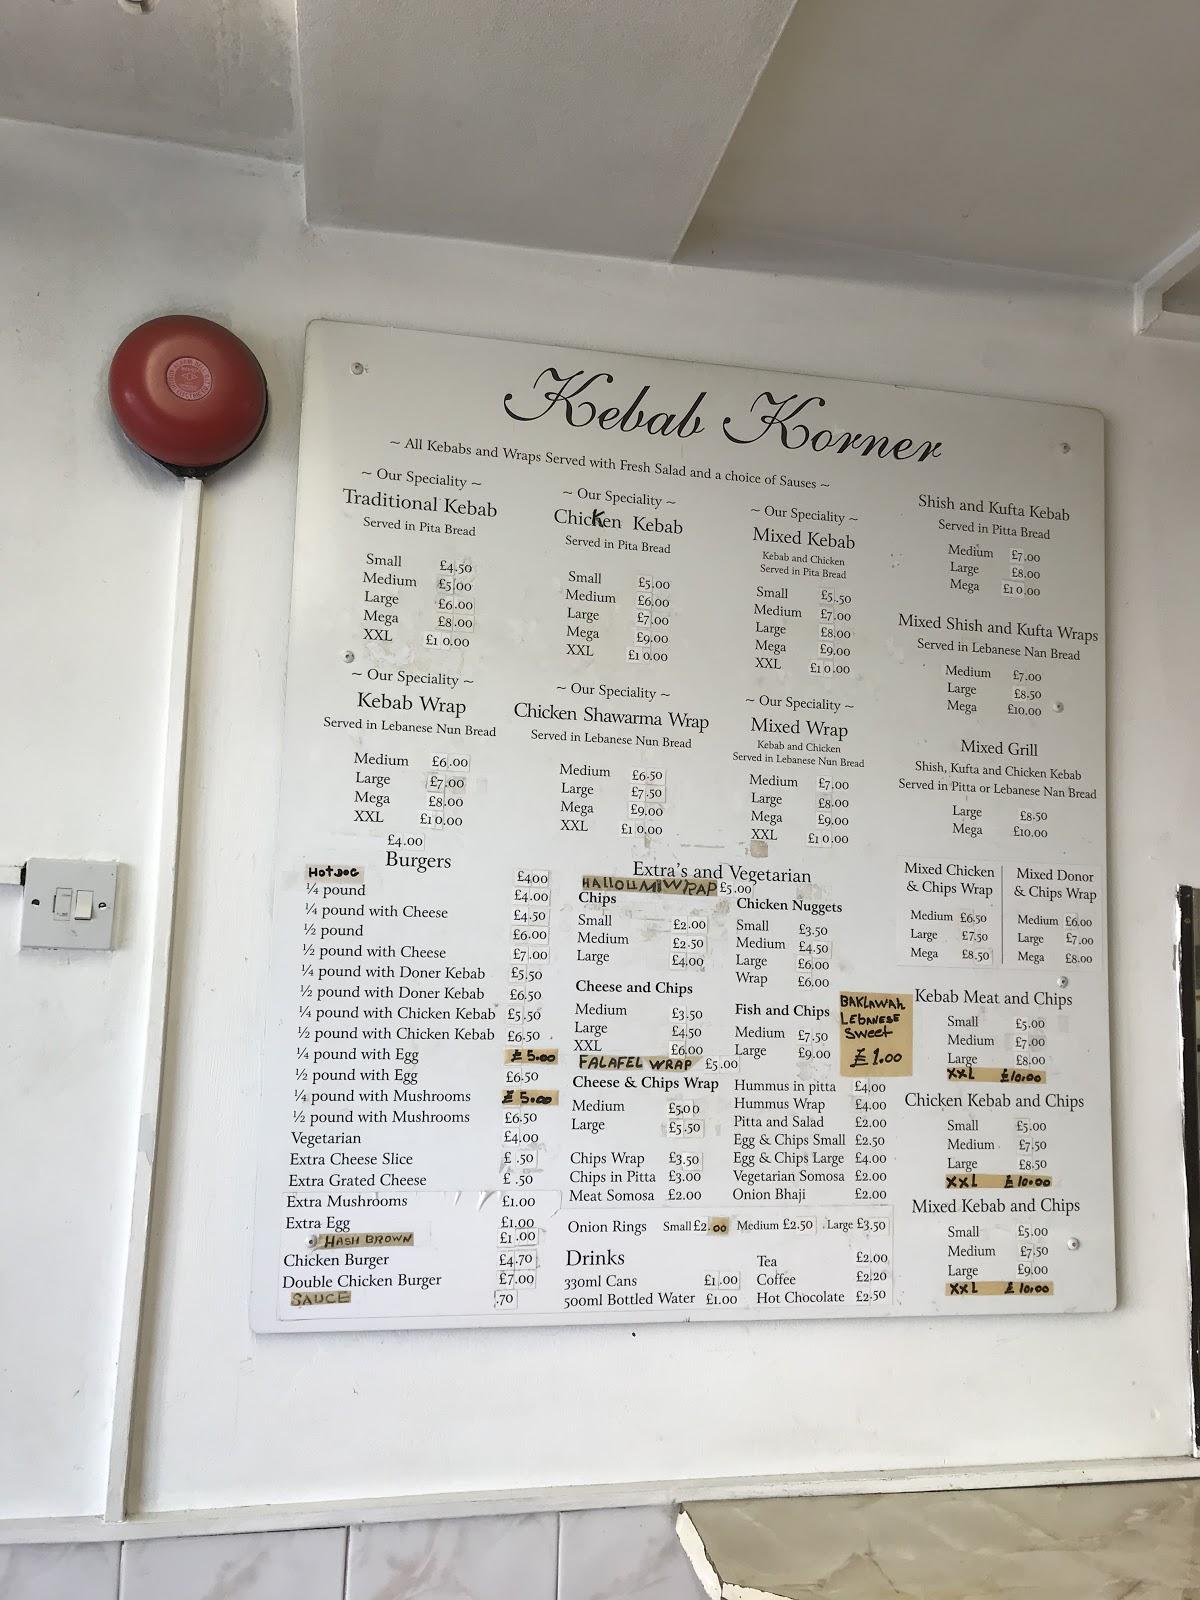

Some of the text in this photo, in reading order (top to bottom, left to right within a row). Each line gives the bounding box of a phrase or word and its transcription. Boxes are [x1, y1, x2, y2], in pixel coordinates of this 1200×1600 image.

[503, 367, 942, 462] Kebab Korner
[404, 438, 816, 489] All Kebabs and Wraps Served with Fresh Salad and a choice of Sauses
[342, 488, 497, 517] Traditional Kebab
[918, 494, 1070, 521] Shish and Kufta Kebab
[752, 526, 855, 549] Mixed Kebab
[938, 518, 1050, 540] Served in Pitta Bread
[898, 613, 1098, 645] Mixed Shish and Kufta Wraps
[945, 664, 1042, 682] Medium £7.00
[947, 682, 1042, 701] Large £8.50
[357, 691, 466, 719] Kebab Wrap
[947, 699, 1042, 716] Mega £10.00
[514, 702, 709, 734] Chicken Shawarma Wrap
[531, 728, 692, 750] Served in Lebanese Nun Bread
[757, 738, 841, 754] Kebab and Chicken
[961, 739, 1038, 757] Mixed Grill
[952, 805, 1048, 822] Large £8.50
[952, 822, 1048, 838] Mega £10.00
[385, 850, 452, 874] Burgers
[904, 861, 995, 878] Mixed Chicken
[633, 861, 812, 887] Extra's and Vegetarian
[1016, 867, 1094, 882] Mixed Donor
[578, 891, 617, 906] Chips
[906, 880, 993, 899] & Chips Wrap
[736, 897, 843, 914] Chicken Nuggets
[578, 913, 706, 931] Small £2.00
[577, 931, 704, 950] Medium £2.50
[577, 949, 704, 967] Large £4.00
[575, 979, 693, 998] Cheese and Chips
[915, 988, 1073, 1010] Kebab Meat and Chips
[734, 1003, 830, 1021] Fish and Chips
[579, 1054, 693, 1072] FALAFEL WRAP
[734, 1079, 887, 1097] Hummus in pitta £4.00
[905, 1092, 1084, 1112] Chicken Kebab and Chips
[947, 1119, 1047, 1134] Small £5.00
[290, 1130, 539, 1149] Vegetarian £4.00
[947, 1138, 1048, 1151] Medium £7.50
[289, 1152, 413, 1166] Extra Cheese Slice
[570, 1151, 645, 1169] Chips Wrap
[947, 1157, 1047, 1173] Large £8.50
[569, 1169, 702, 1187] Chips in Pitta £3.00
[569, 1188, 702, 1202] Meat Somosa £2.00
[912, 1197, 1080, 1217] Mixed Kebab and Chips
[568, 1220, 647, 1237] Onion Rings
[324, 1232, 412, 1248] HASH BROWN
[283, 1253, 390, 1270] Chicken Burger
[566, 1249, 625, 1267] Drinks
[756, 1251, 888, 1268] Tea £2.00
[282, 1272, 535, 1290] Double Chicken Burger £7.00
[564, 1274, 739, 1291] 330ml Cans £1.00
[756, 1271, 888, 1286] Coffee £2.20
[292, 1291, 351, 1306] SAUCE
[563, 1291, 738, 1309] 500ml Bottled Water £1.00
[756, 1288, 886, 1304] Hot Chocolate £2.50
